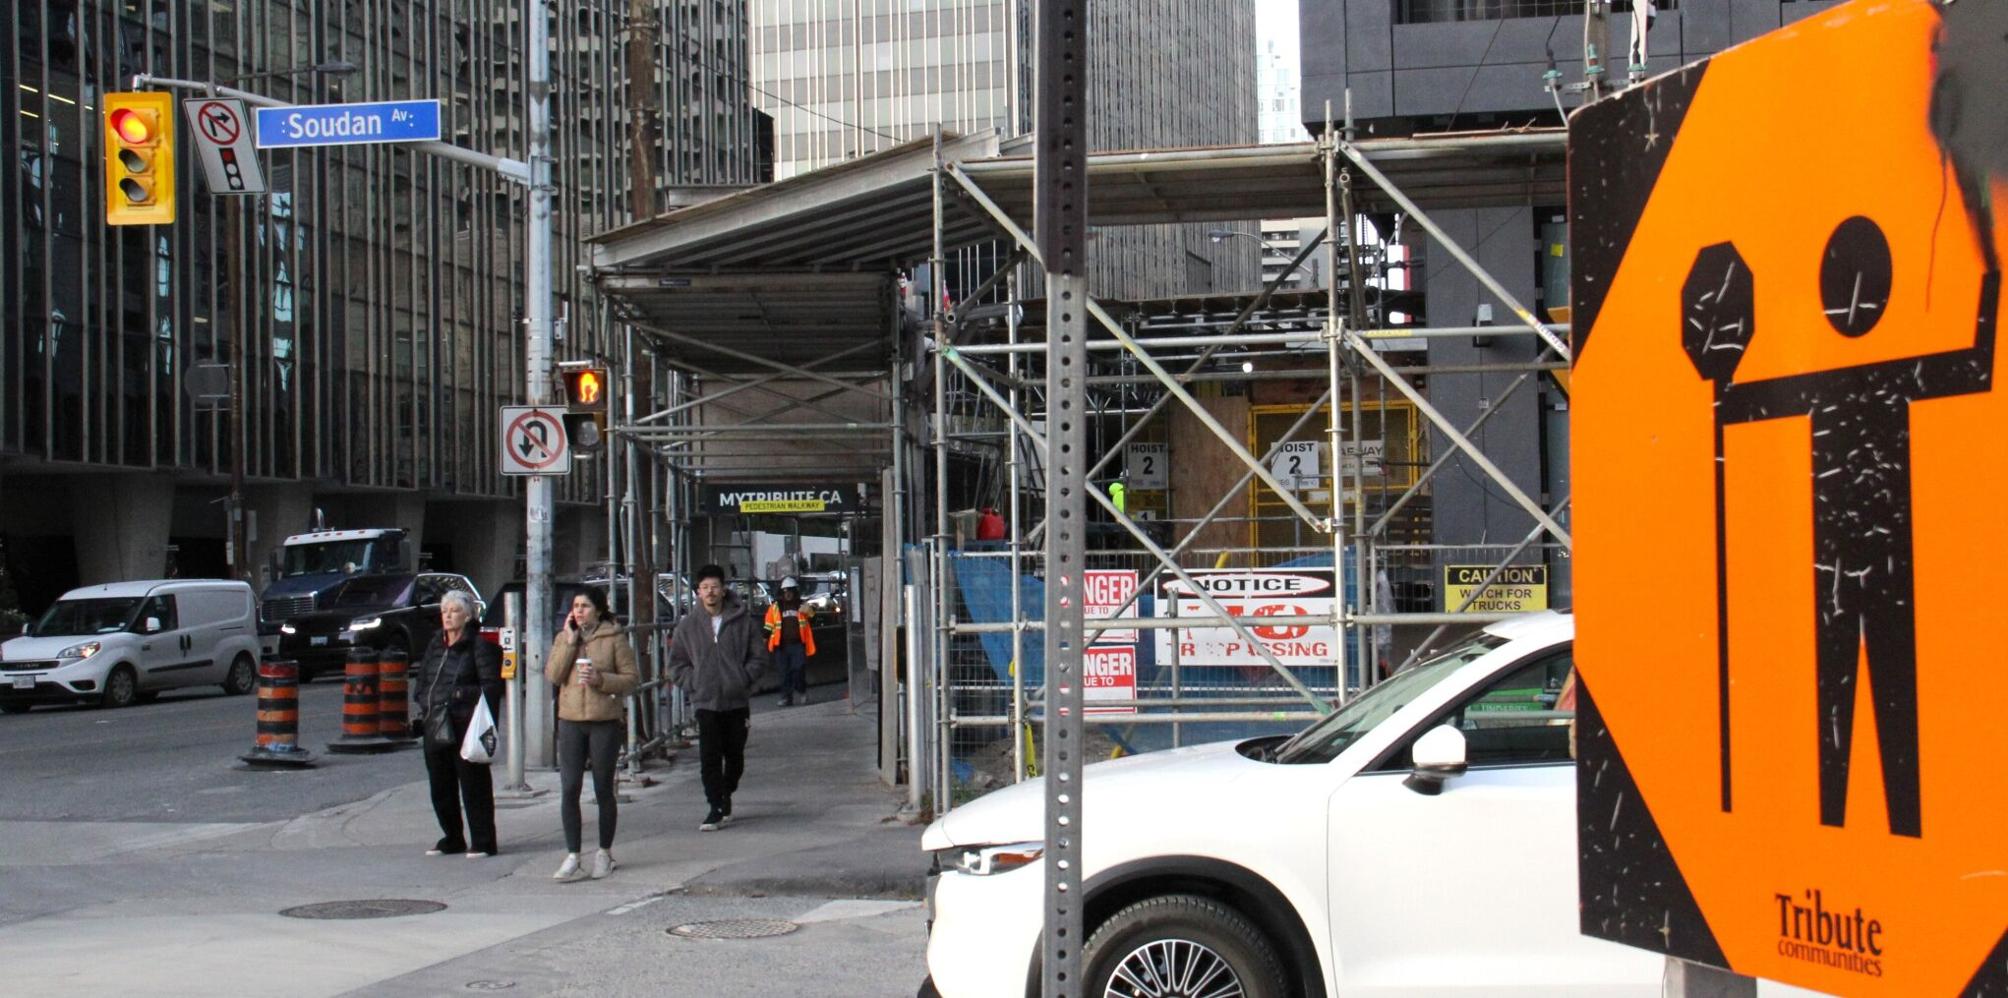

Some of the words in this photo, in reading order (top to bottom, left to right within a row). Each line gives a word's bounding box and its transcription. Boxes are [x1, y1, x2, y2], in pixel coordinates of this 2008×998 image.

[289, 111, 382, 139] Soudan
[392, 109, 408, 122] Av
[1131, 444, 1165, 453] HOIST
[1143, 456, 1154, 475] 2
[1288, 455, 1301, 475] 2
[719, 490, 842, 507] MYTRIBUTECA
[745, 501, 786, 510] PEDESTRIAN
[787, 500, 820, 509] WALKWAY
[1084, 575, 1133, 605] NGER
[1195, 578, 1302, 591] NOTICE
[1459, 589, 1503, 599] WCH
[1507, 589, 1532, 599] FOR
[1084, 606, 1095, 615] UE
[1098, 606, 1109, 615] TO
[1472, 600, 1521, 611] TRUCKS
[1083, 653, 1132, 676] NGER
[1084, 677, 1098, 687] UE
[1100, 676, 1115, 687] TO
[1775, 888, 1883, 956] Tribute
[1777, 939, 1883, 978] communities
